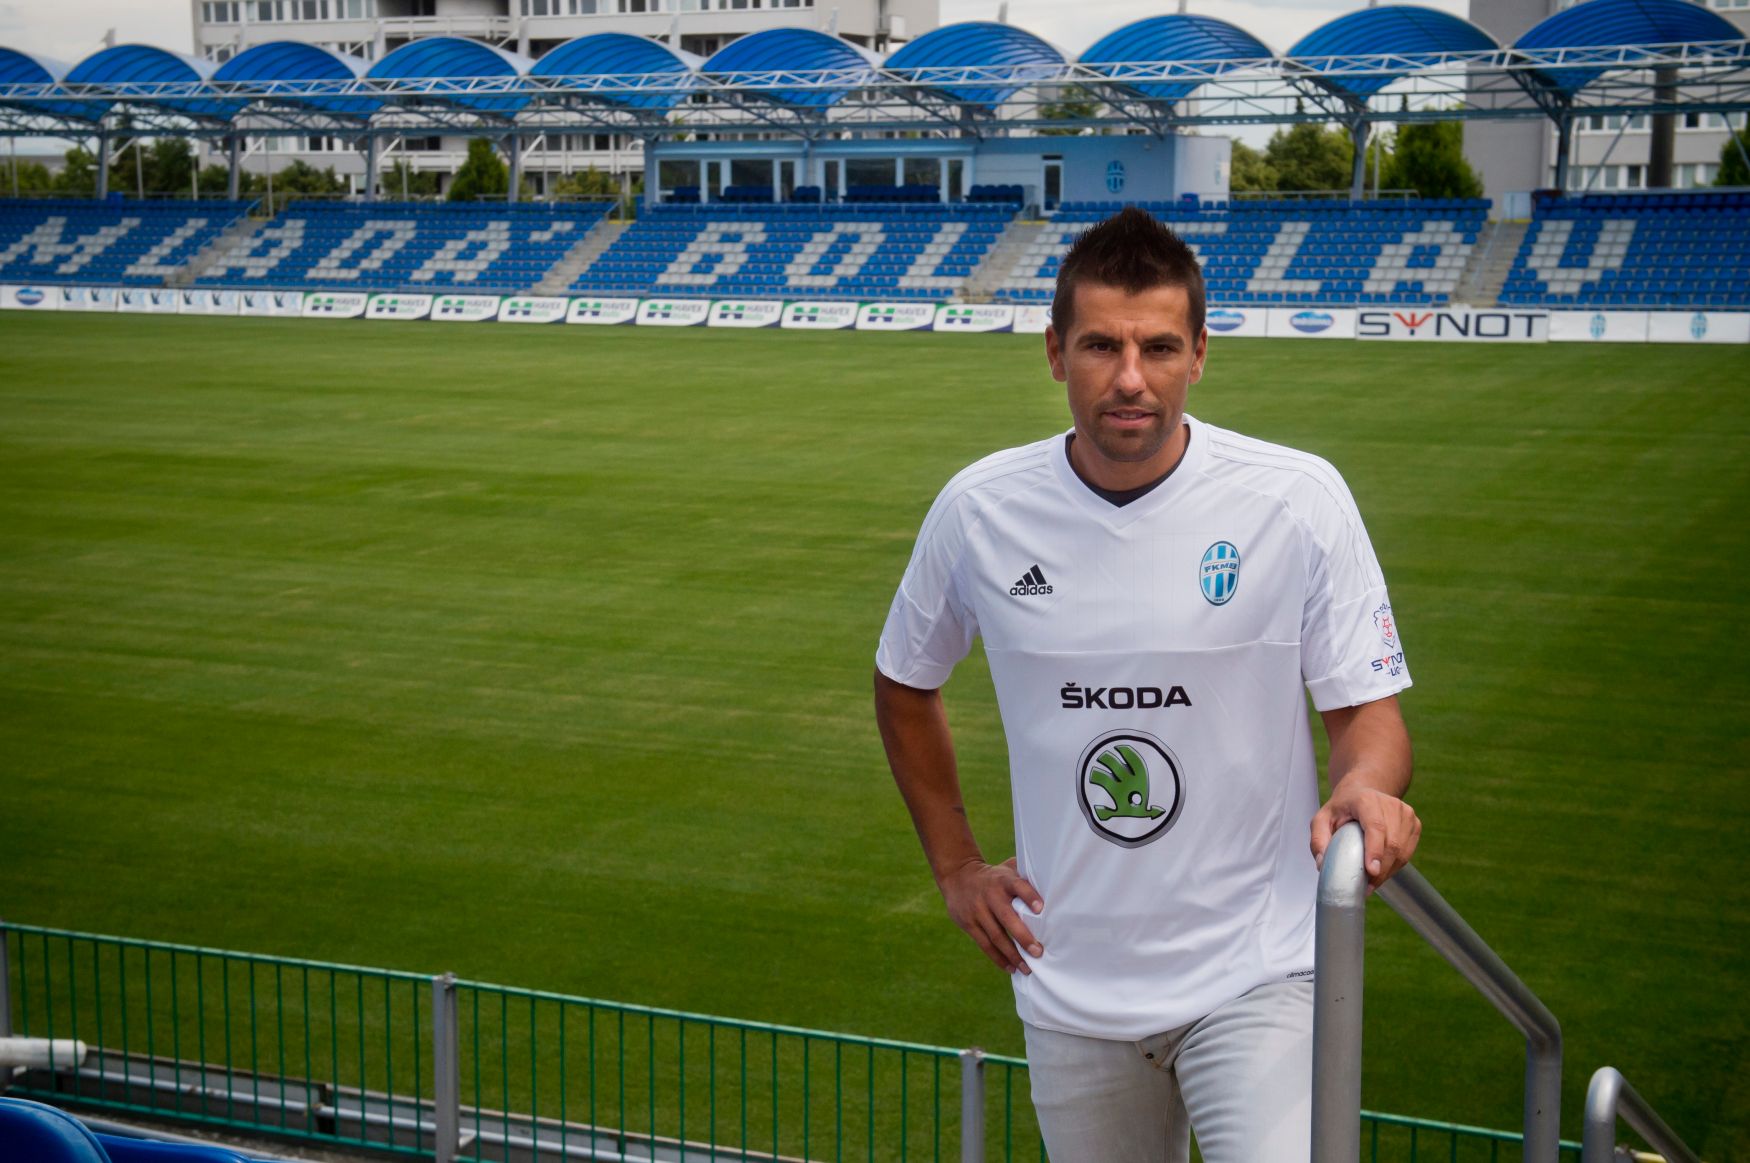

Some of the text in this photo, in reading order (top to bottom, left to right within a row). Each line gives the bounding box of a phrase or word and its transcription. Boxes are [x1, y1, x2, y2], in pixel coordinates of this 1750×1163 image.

[656, 220, 1637, 294] BOLELAV
[1359, 312, 1548, 338] SYNOT
[1204, 562, 1238, 573] FKMB
[1009, 584, 1054, 596] adidas
[1060, 682, 1193, 710] ŠKODA
